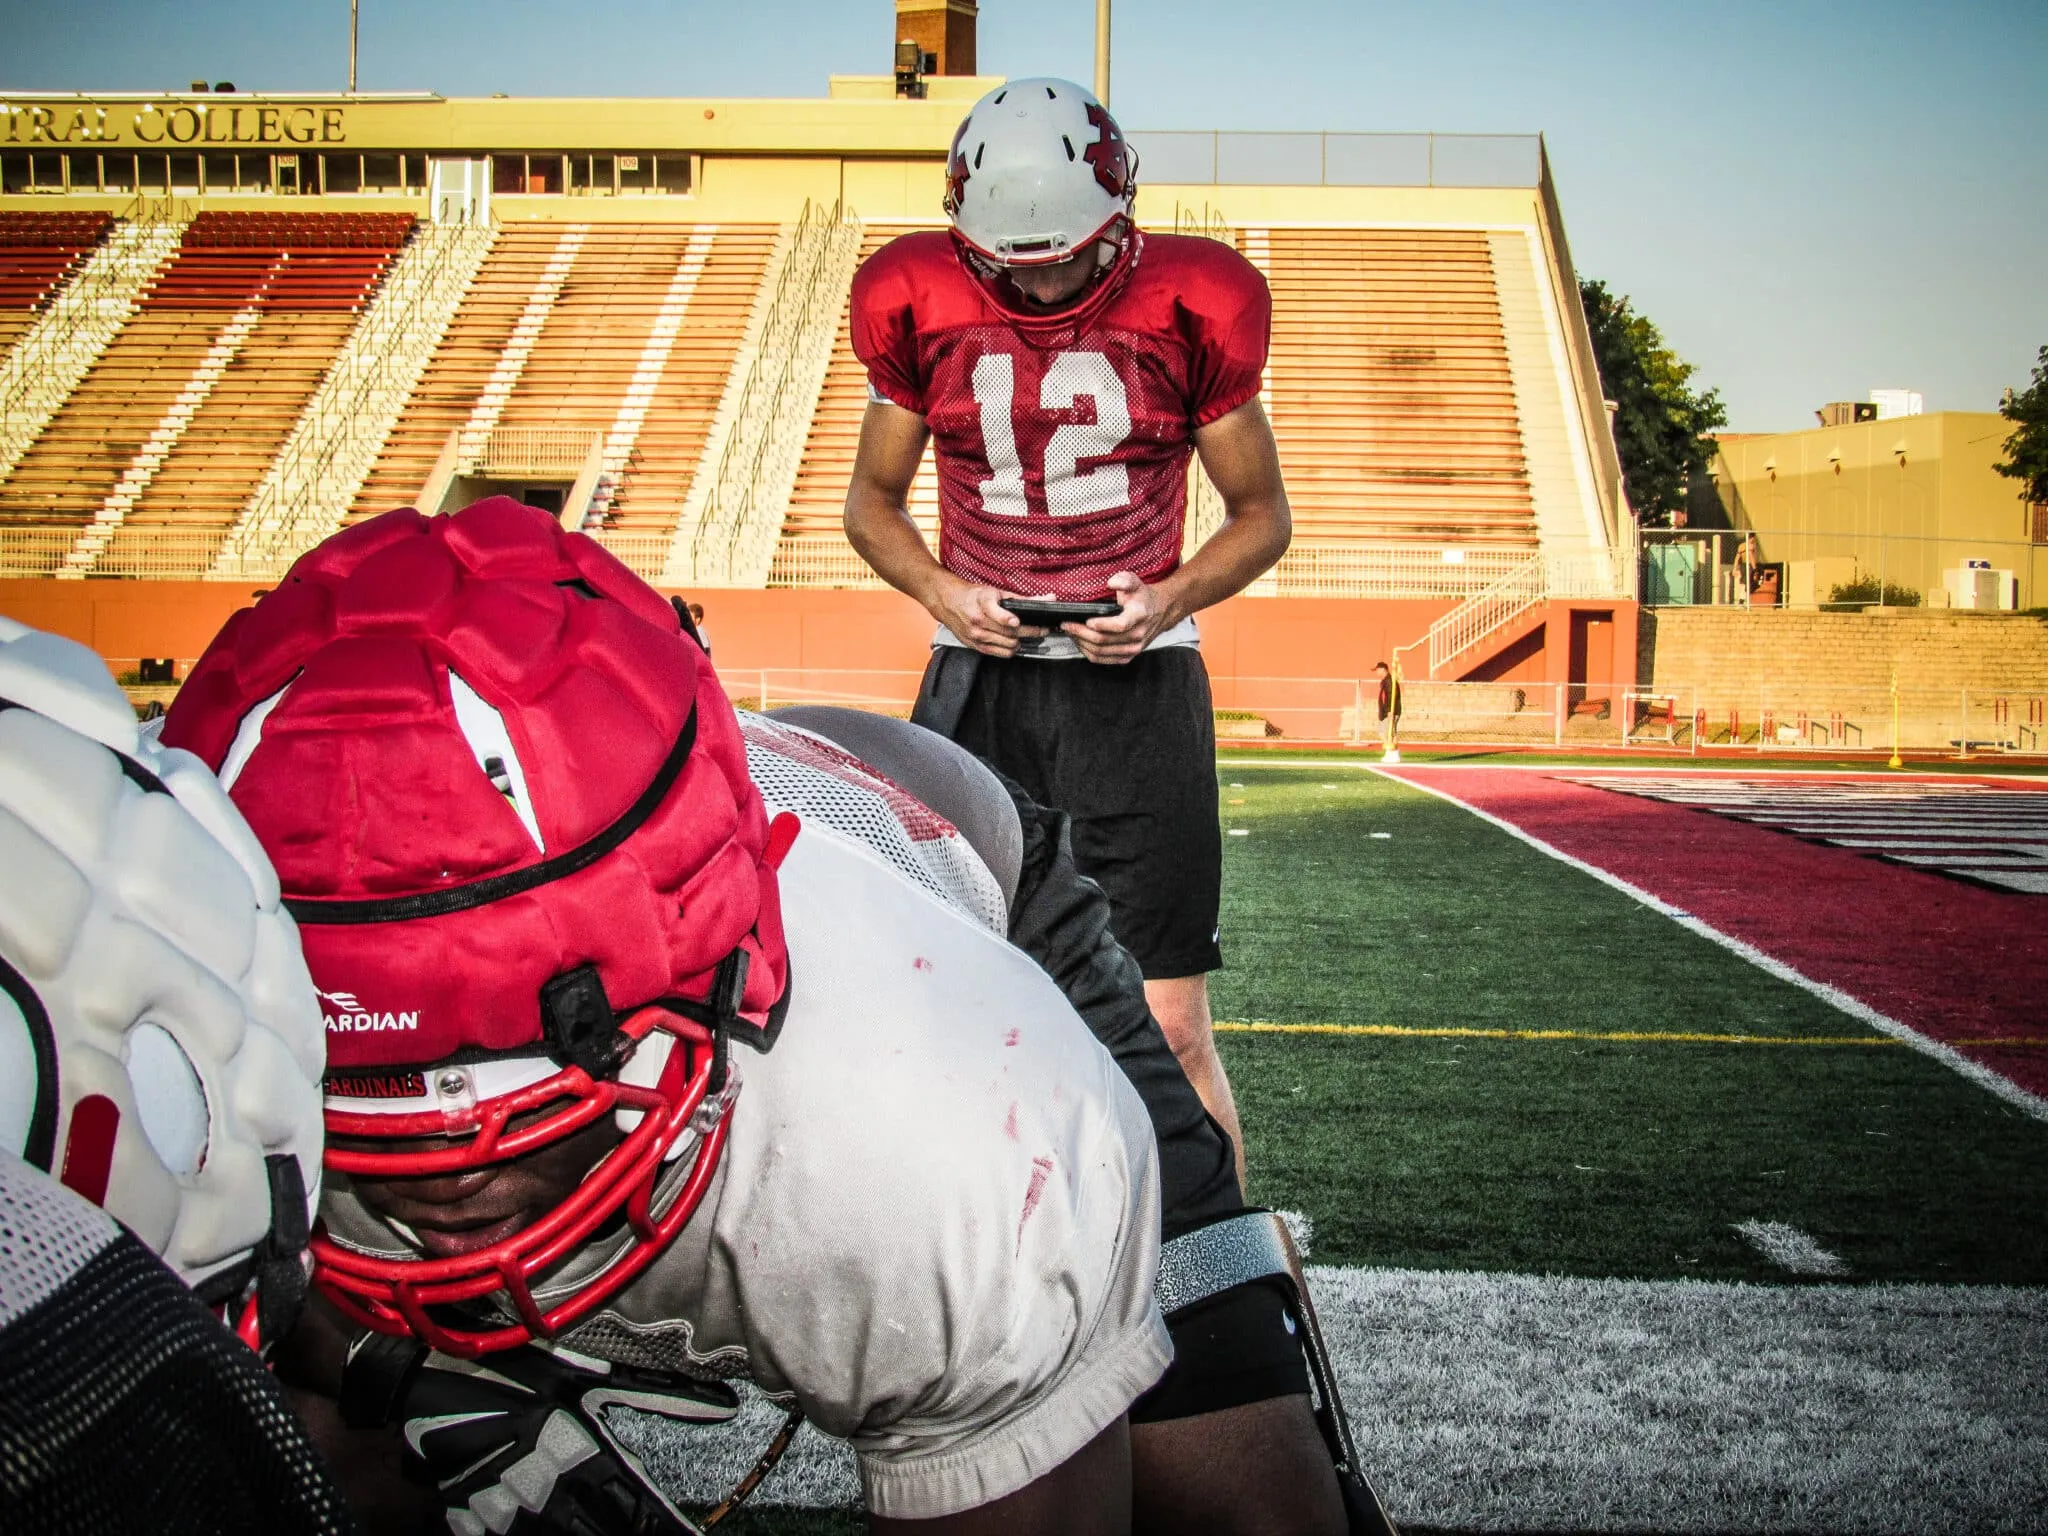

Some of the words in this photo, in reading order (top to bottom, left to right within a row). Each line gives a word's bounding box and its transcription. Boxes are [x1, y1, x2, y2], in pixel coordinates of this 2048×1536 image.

[0, 106, 119, 142] TRAL
[133, 106, 346, 142] COLLEGE
[622, 158, 637, 168] 109
[971, 352, 1132, 517] 12
